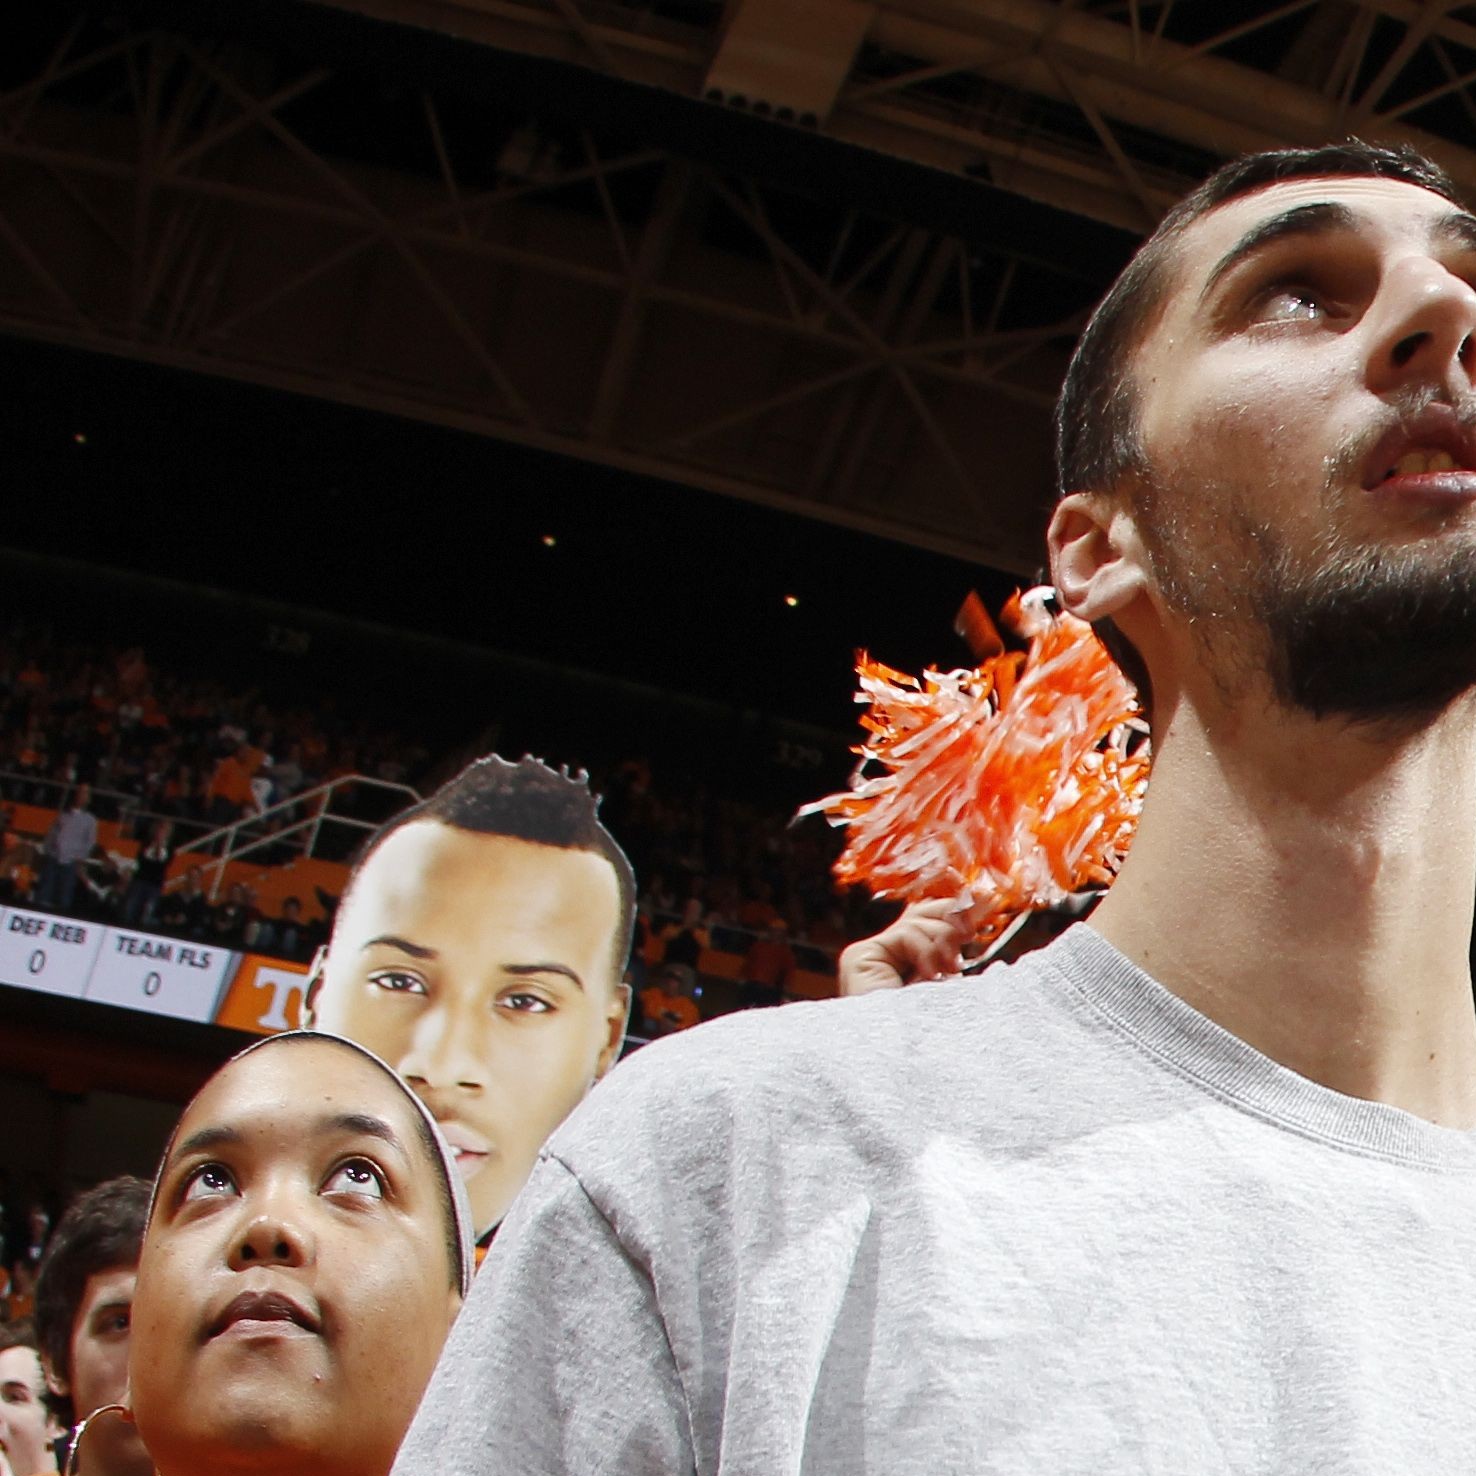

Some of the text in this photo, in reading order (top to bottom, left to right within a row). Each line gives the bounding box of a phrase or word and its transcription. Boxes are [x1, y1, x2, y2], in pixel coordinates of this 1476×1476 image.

[8, 914, 86, 945] DEF REB
[27, 948, 46, 975] 0
[115, 935, 212, 970] TEAM FLS
[145, 971, 162, 997] 0
[254, 967, 308, 1030] T
